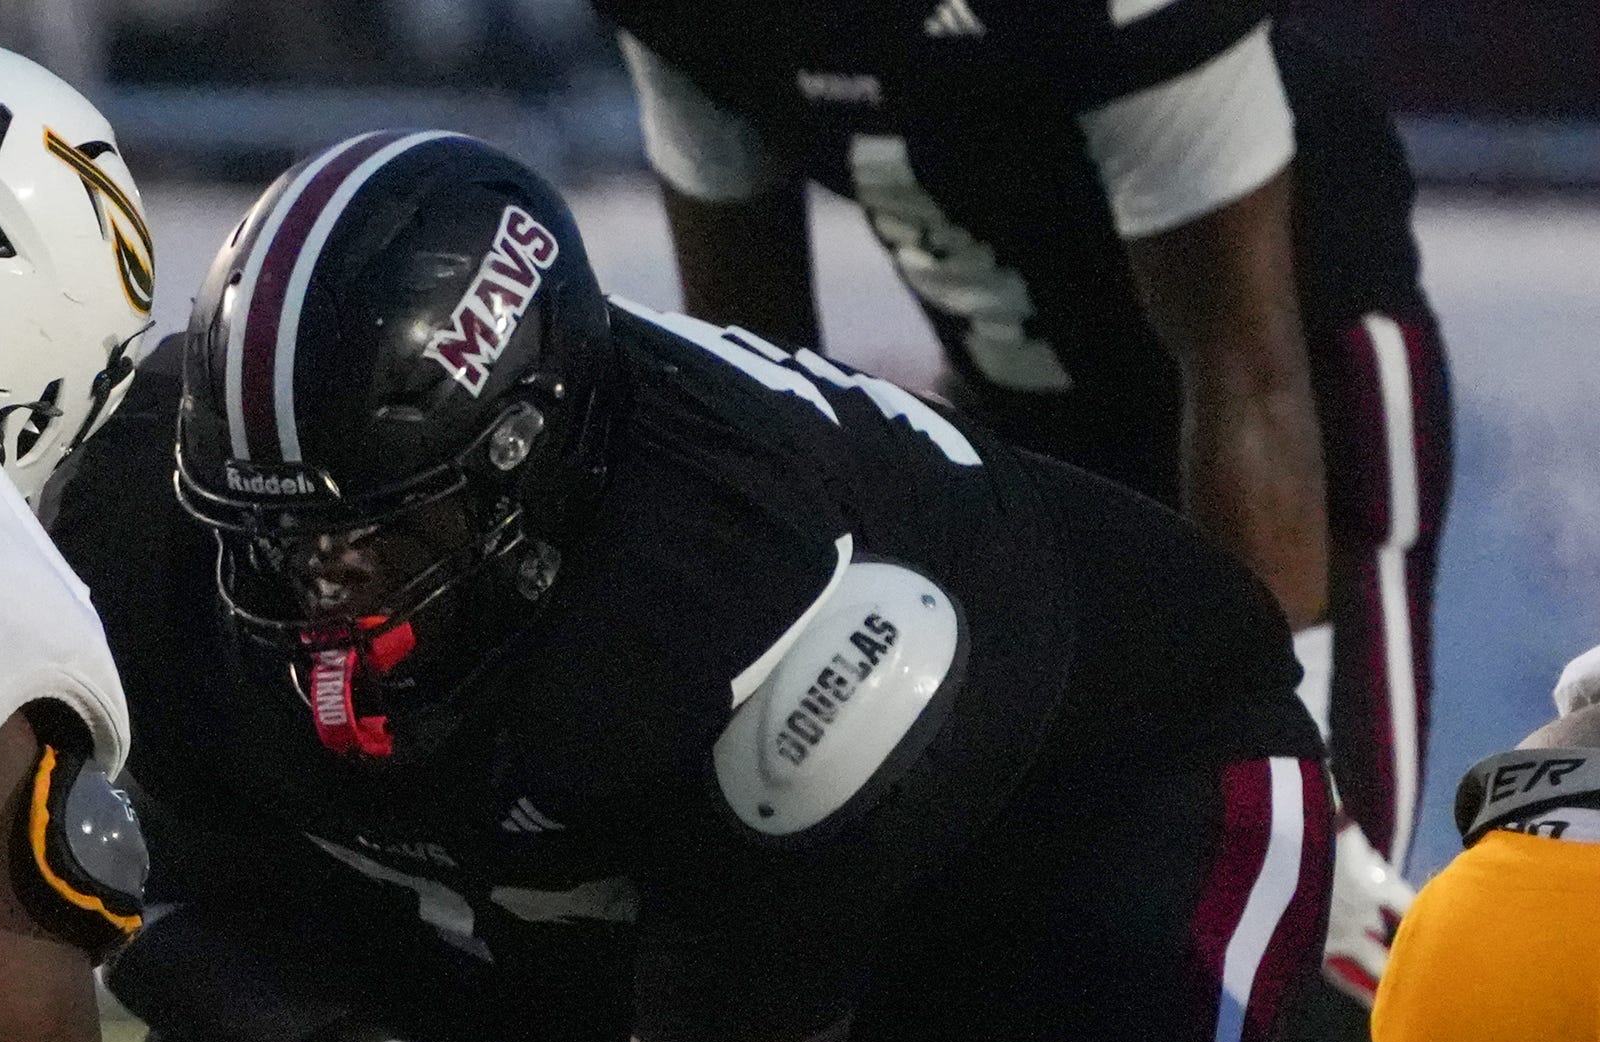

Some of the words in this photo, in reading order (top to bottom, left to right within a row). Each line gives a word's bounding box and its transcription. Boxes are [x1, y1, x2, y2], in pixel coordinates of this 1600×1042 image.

[423, 205, 559, 398] MAVS
[776, 612, 899, 767] DOUGLAS
[1484, 758, 1587, 805] ER
